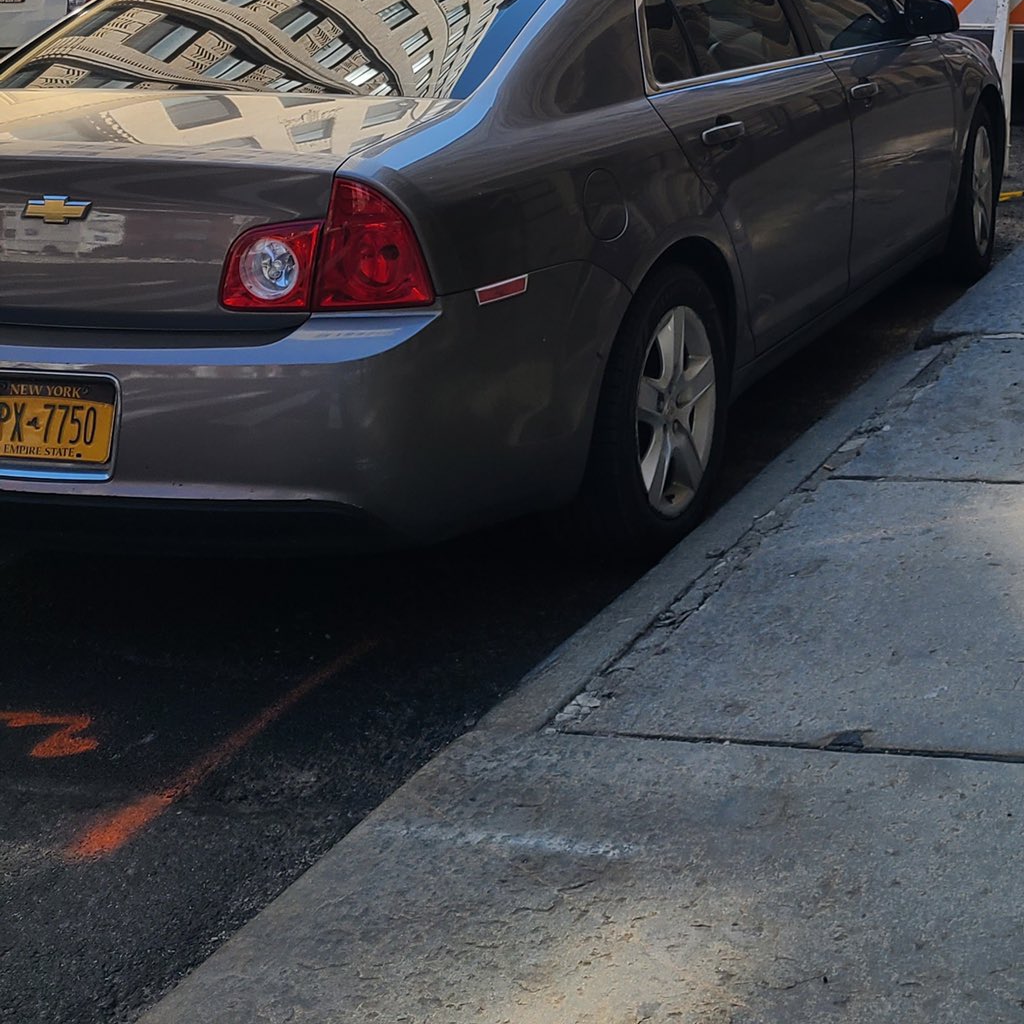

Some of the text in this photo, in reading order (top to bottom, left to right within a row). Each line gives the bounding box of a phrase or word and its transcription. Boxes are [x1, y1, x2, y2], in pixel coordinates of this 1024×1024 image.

[9, 383, 82, 398] NEW YORK
[43, 403, 97, 445] 7750
[3, 443, 75, 458] EMPIRE STATE
